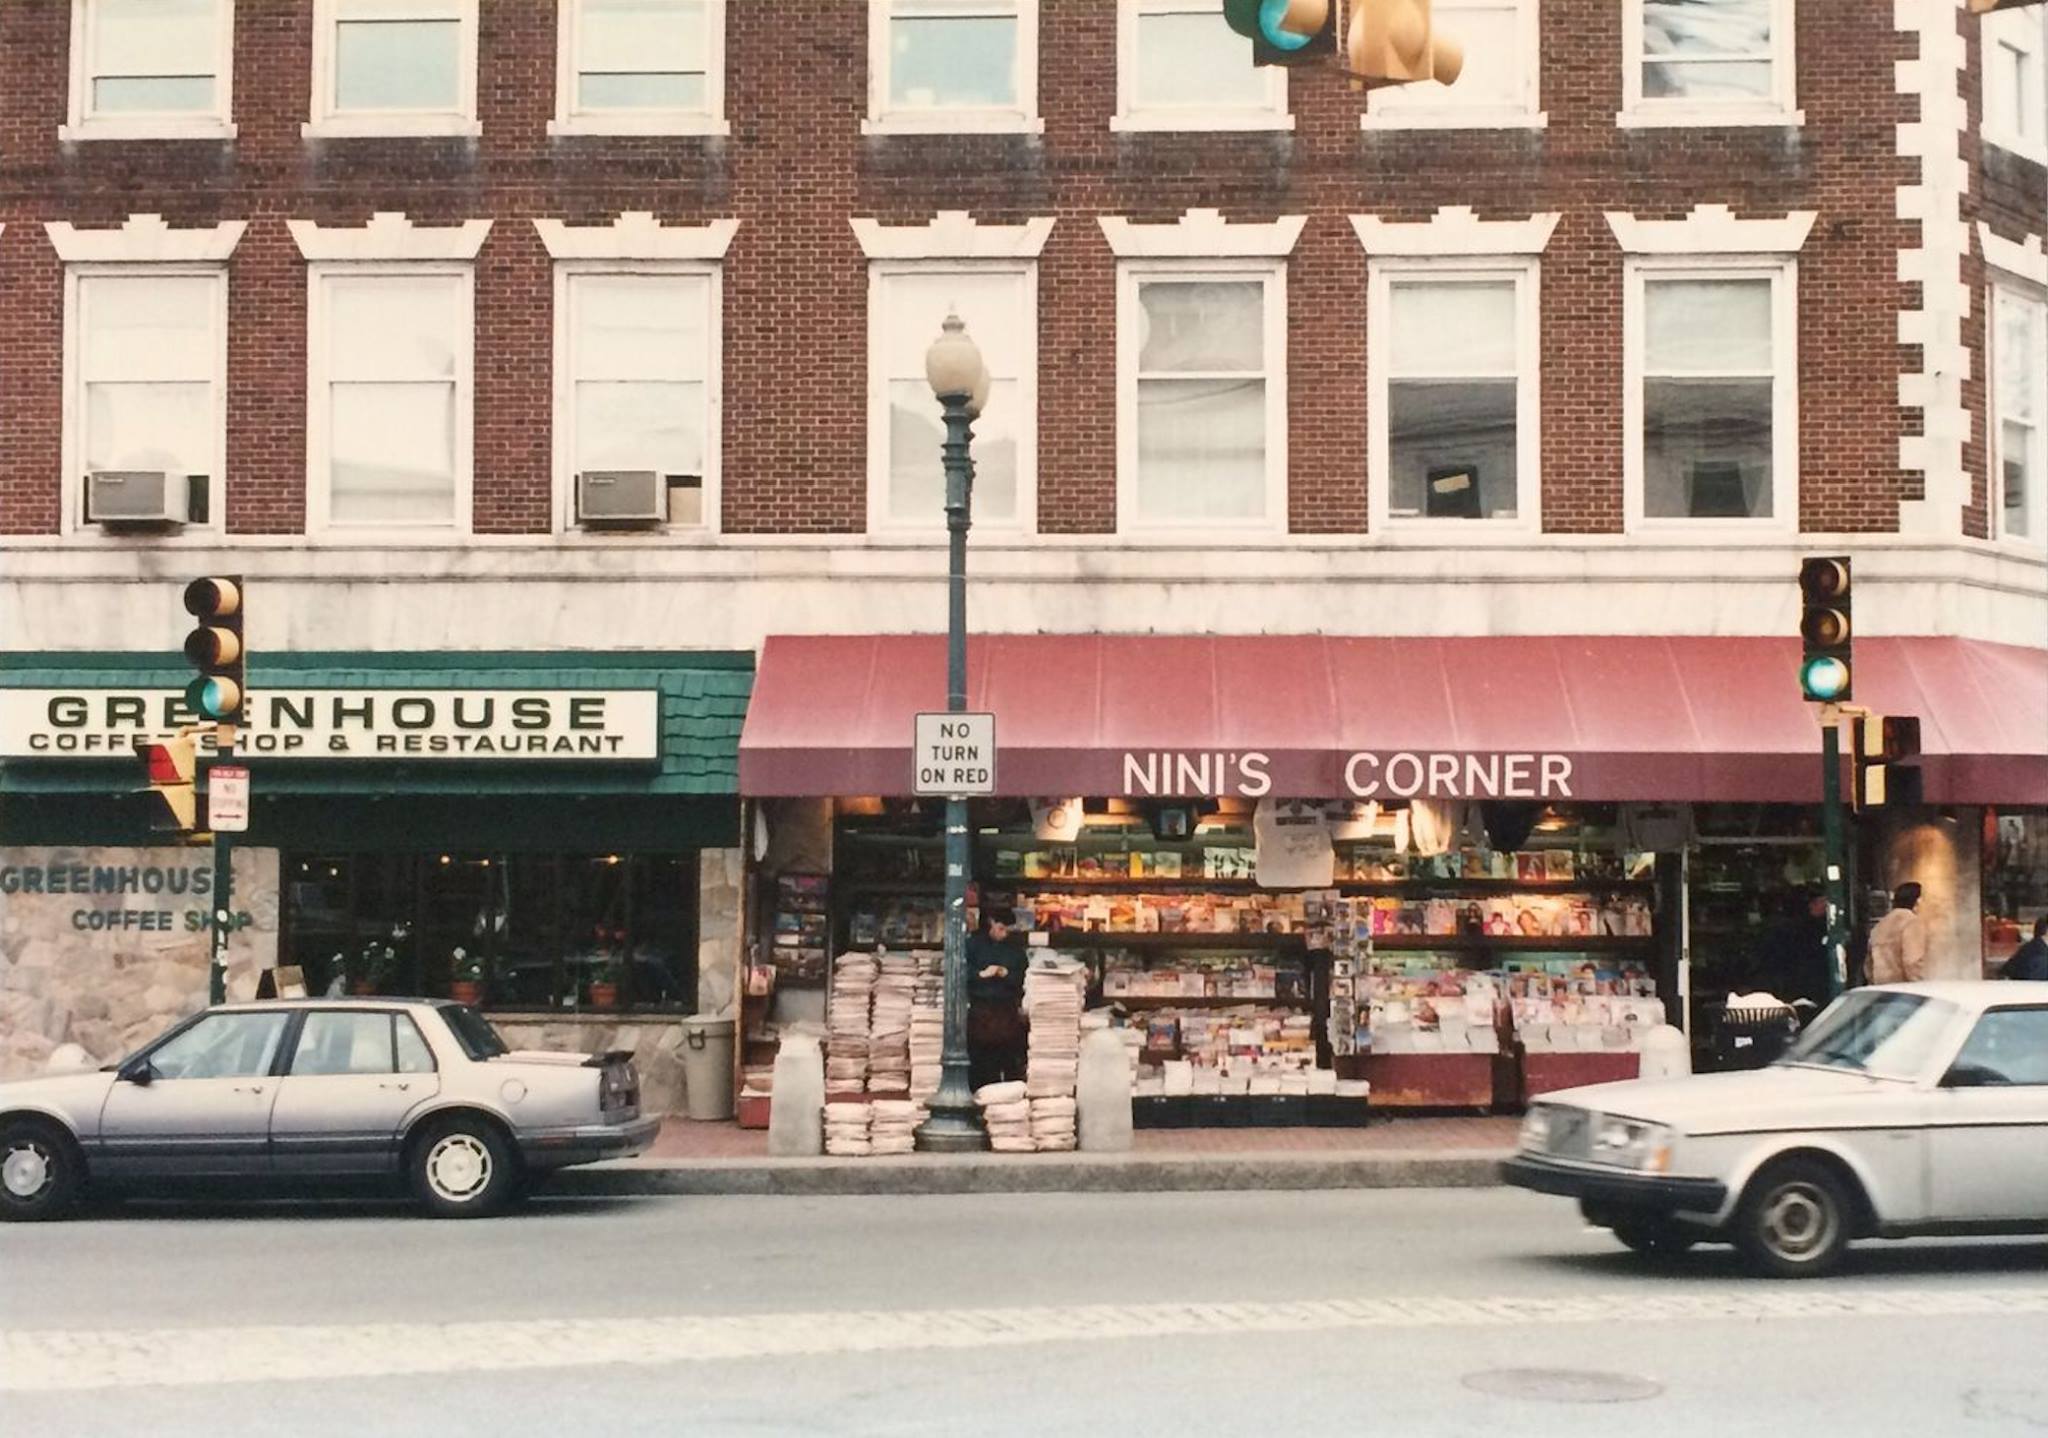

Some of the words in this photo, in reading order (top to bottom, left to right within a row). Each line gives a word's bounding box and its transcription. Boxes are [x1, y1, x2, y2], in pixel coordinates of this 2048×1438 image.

[47, 696, 606, 729] GRENHOUSE
[940, 723, 970, 738] NO
[29, 733, 175, 751] COFFE
[328, 735, 350, 751] &
[376, 734, 624, 752] RESTAURANT
[931, 745, 978, 761] TURN
[921, 768, 945, 783] ON
[954, 768, 988, 783] RED
[1124, 752, 1272, 797] NINI'S
[1344, 752, 1573, 797] CORNER
[0, 866, 235, 895] GREENHOUS
[72, 909, 172, 931] COFFEE
